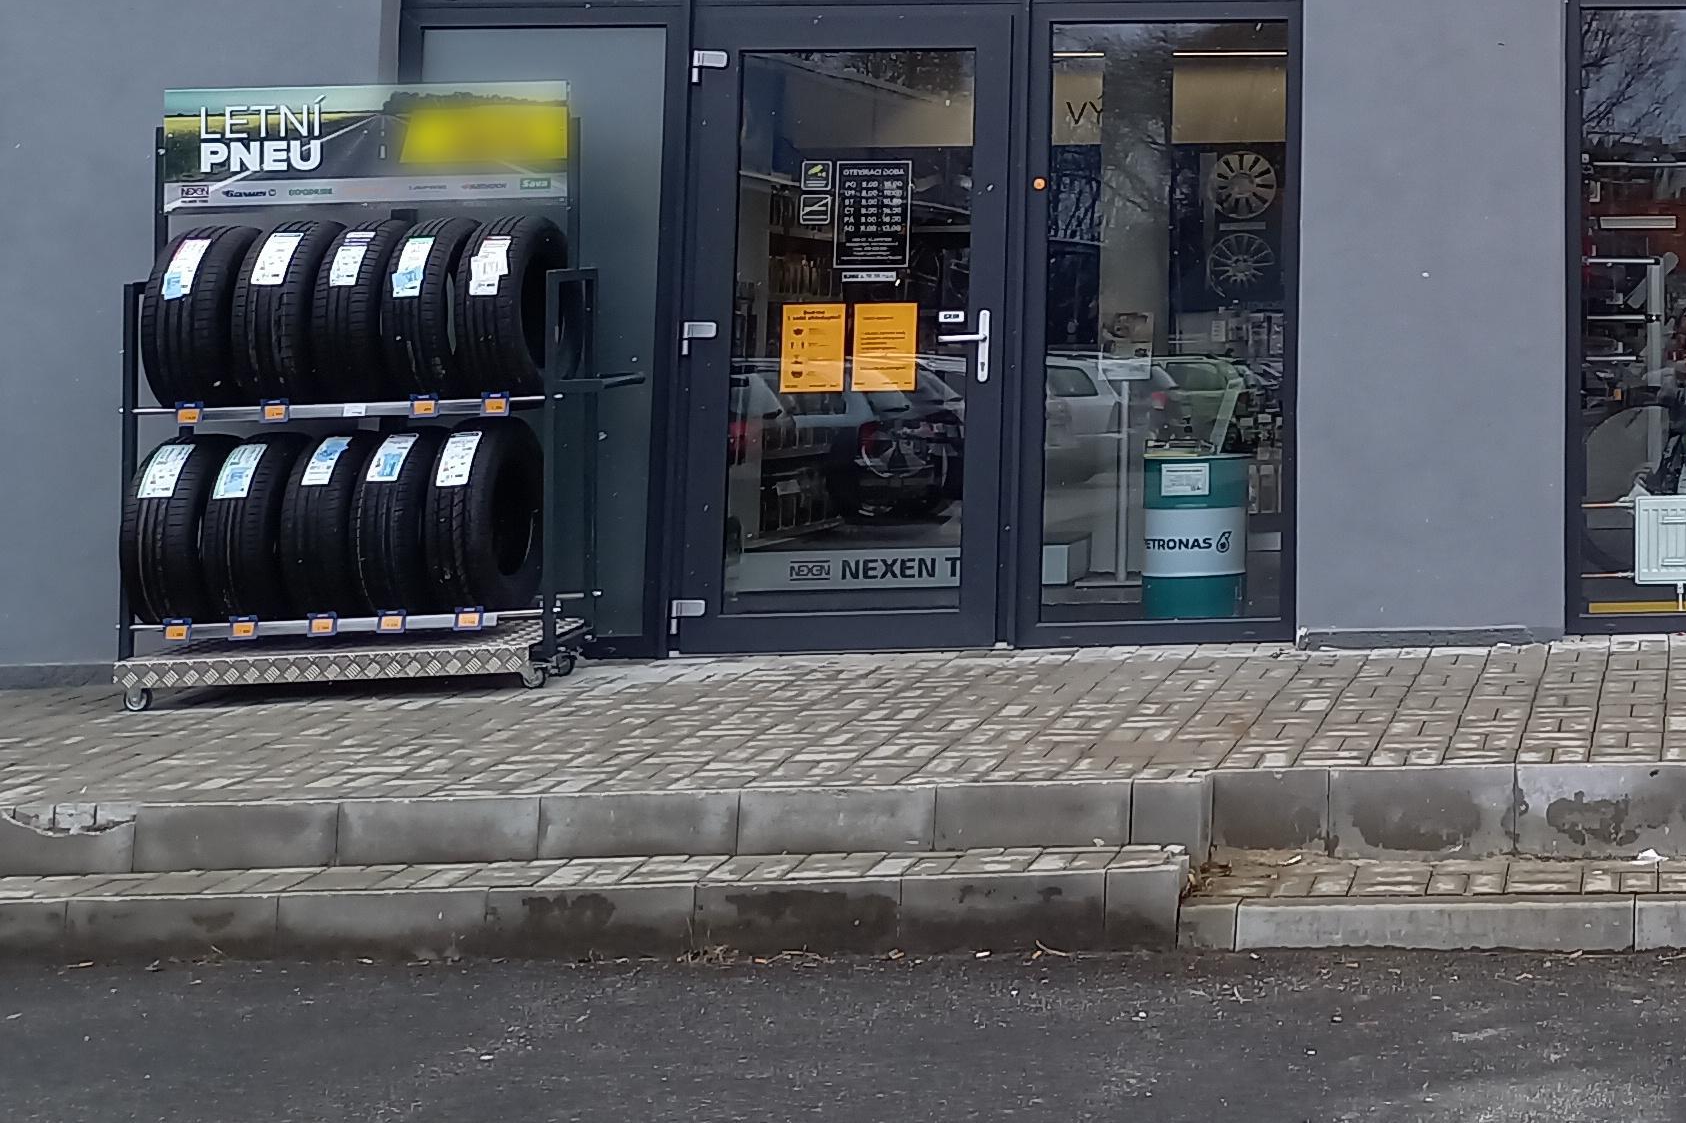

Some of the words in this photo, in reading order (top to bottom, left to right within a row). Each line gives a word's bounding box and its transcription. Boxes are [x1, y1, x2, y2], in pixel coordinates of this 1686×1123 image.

[200, 94, 327, 139] LETNÍ
[200, 139, 321, 173] PNEU
[1144, 537, 1213, 551] ETRONAS
[790, 562, 830, 579] NEXEN
[841, 557, 937, 580] NEXEN
